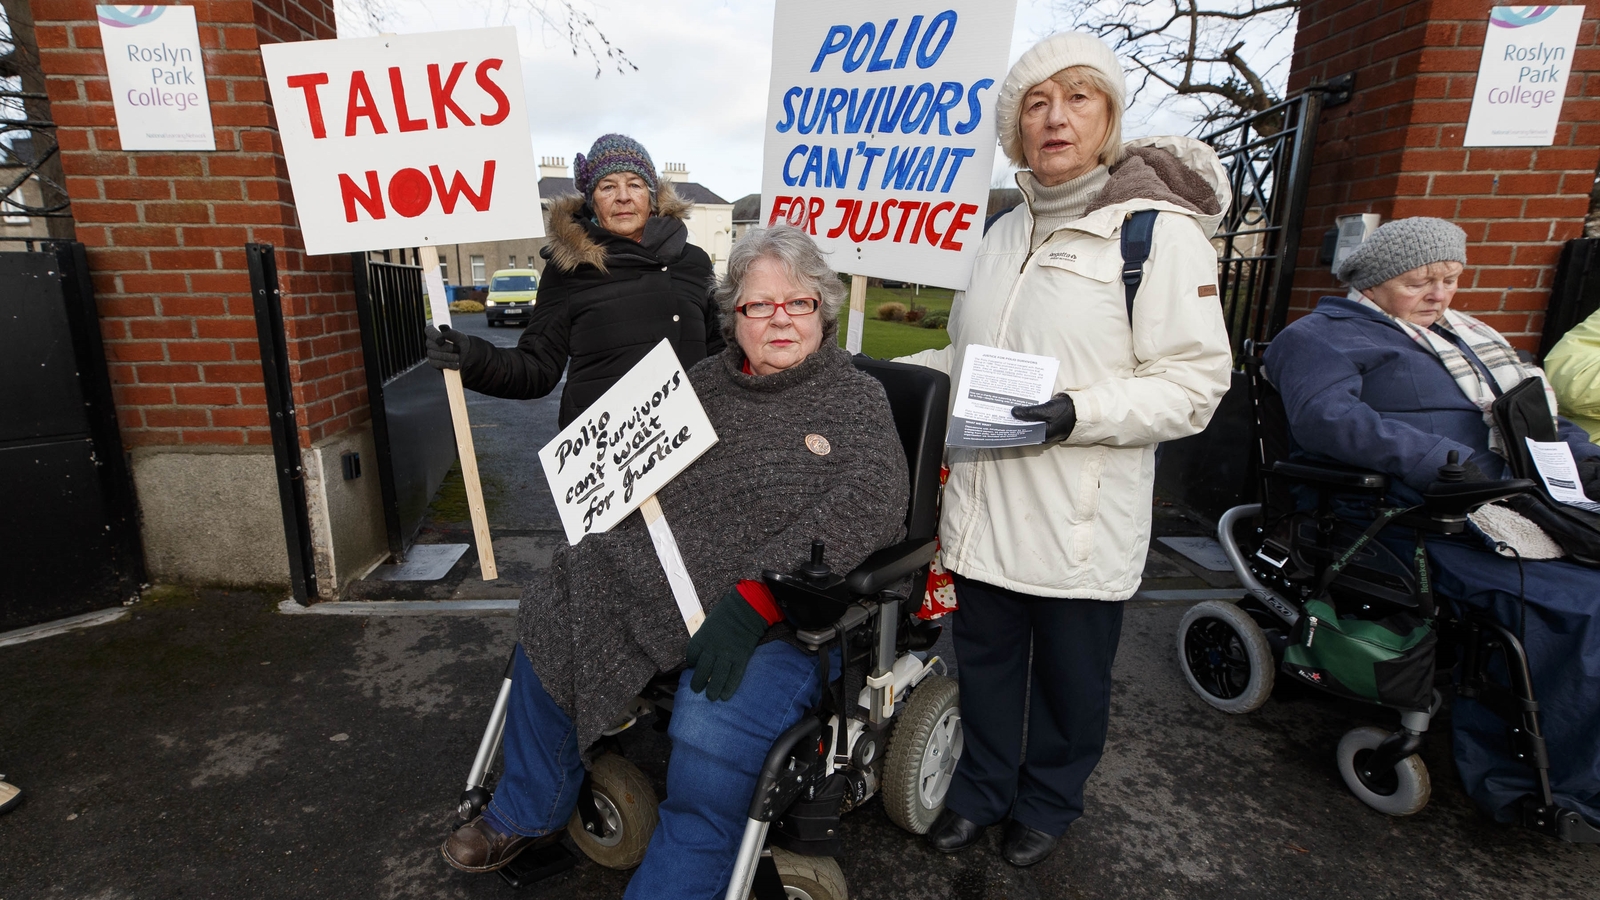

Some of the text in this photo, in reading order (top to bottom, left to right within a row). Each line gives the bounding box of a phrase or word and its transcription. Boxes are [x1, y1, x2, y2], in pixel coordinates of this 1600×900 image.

[127, 42, 193, 67] Roslyn
[810, 9, 958, 73] POLIO
[1503, 42, 1566, 65] Roslyn
[151, 65, 195, 85] Park
[1518, 64, 1561, 84] Park
[127, 87, 199, 112] College
[286, 58, 511, 139] TALKS
[775, 78, 995, 137] SURVIVORS
[1487, 85, 1556, 109] College
[782, 141, 976, 193] CAN'T WAIT
[337, 160, 496, 223] NOW
[768, 195, 979, 252] FOR JUSTICE
[554, 411, 611, 475] Polio
[566, 415, 662, 504] can't wait
[582, 490, 615, 533] for
[1340, 534, 1370, 562] Heineken
[1419, 558, 1429, 594] Heineken
[1252, 588, 1293, 617] A200
